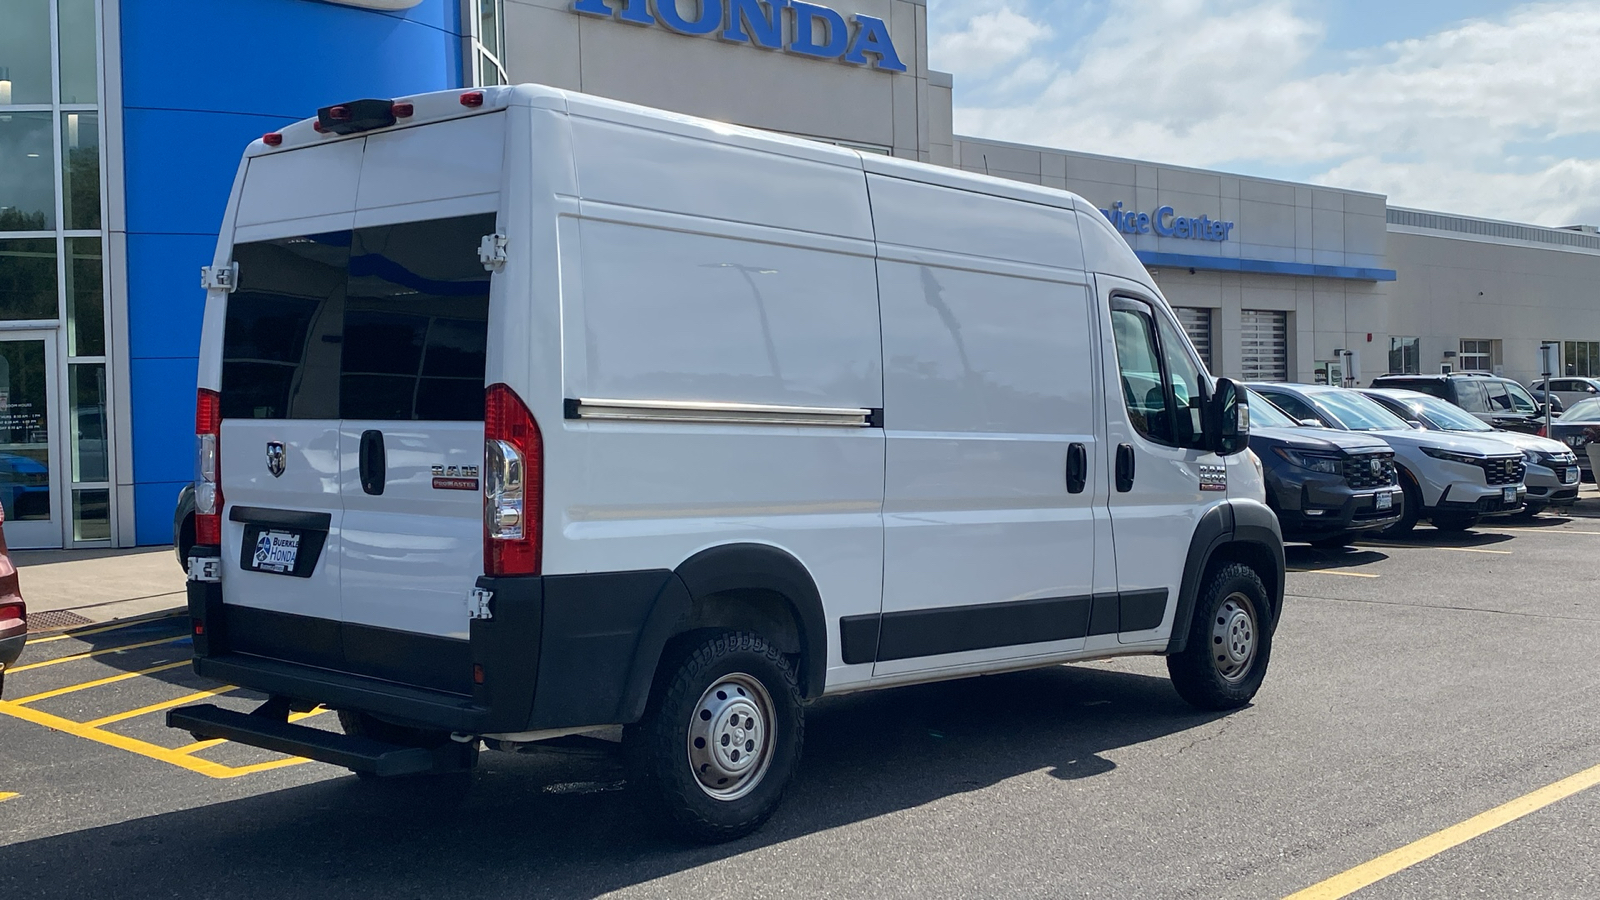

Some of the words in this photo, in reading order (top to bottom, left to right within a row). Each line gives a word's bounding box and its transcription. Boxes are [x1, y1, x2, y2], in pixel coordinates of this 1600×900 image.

[1154, 205, 1234, 241] Center
[431, 464, 479, 477] RAM
[270, 548, 296, 562] HONDA
